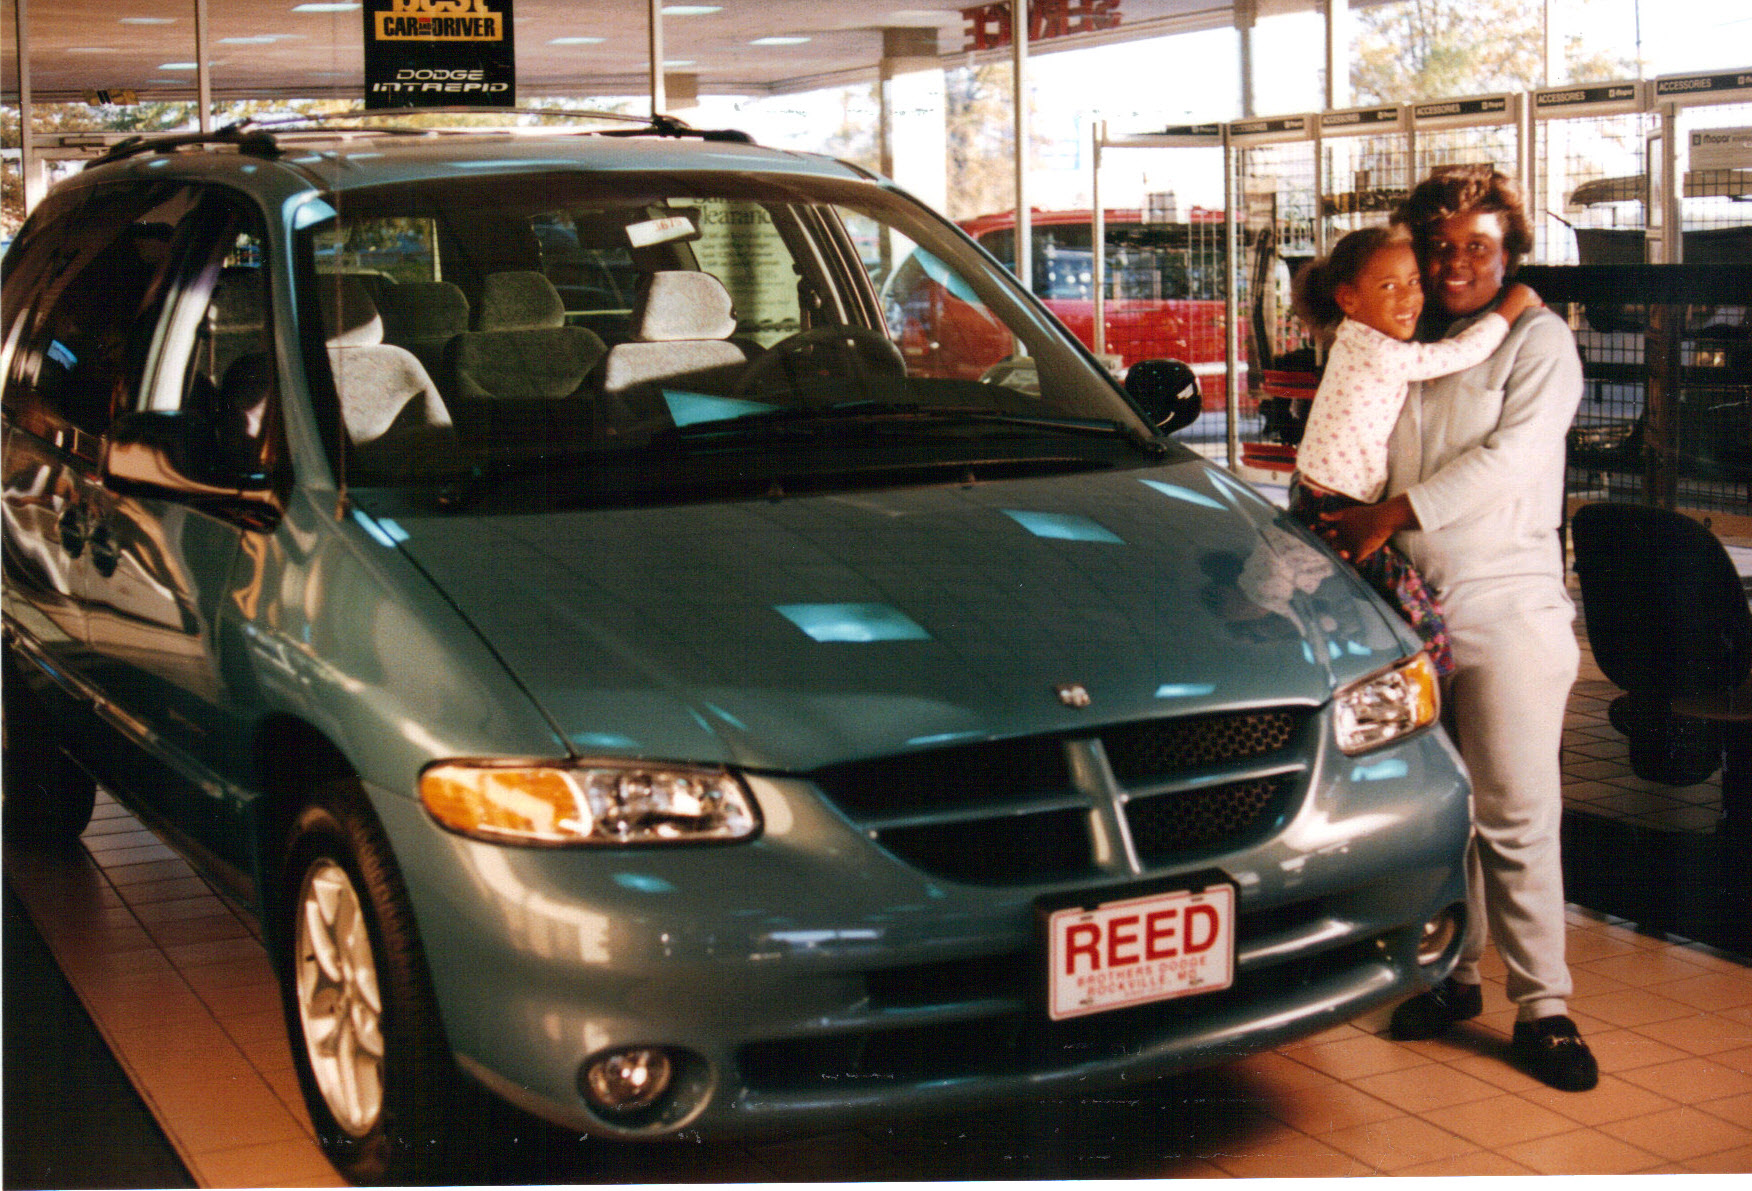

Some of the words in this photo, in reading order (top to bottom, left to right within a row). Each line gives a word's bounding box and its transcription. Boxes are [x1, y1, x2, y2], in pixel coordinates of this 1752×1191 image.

[383, 16, 419, 36] CAR
[431, 17, 495, 37] DRIVER
[396, 69, 484, 80] DODGE
[372, 82, 509, 93] INTREPID
[1658, 79, 1712, 91] ACCESSORIES
[1538, 91, 1585, 103] ACCESSORIES
[1065, 904, 1219, 975] REED
[1077, 965, 1153, 987] BROTHERS
[1158, 955, 1206, 973] DODGE
